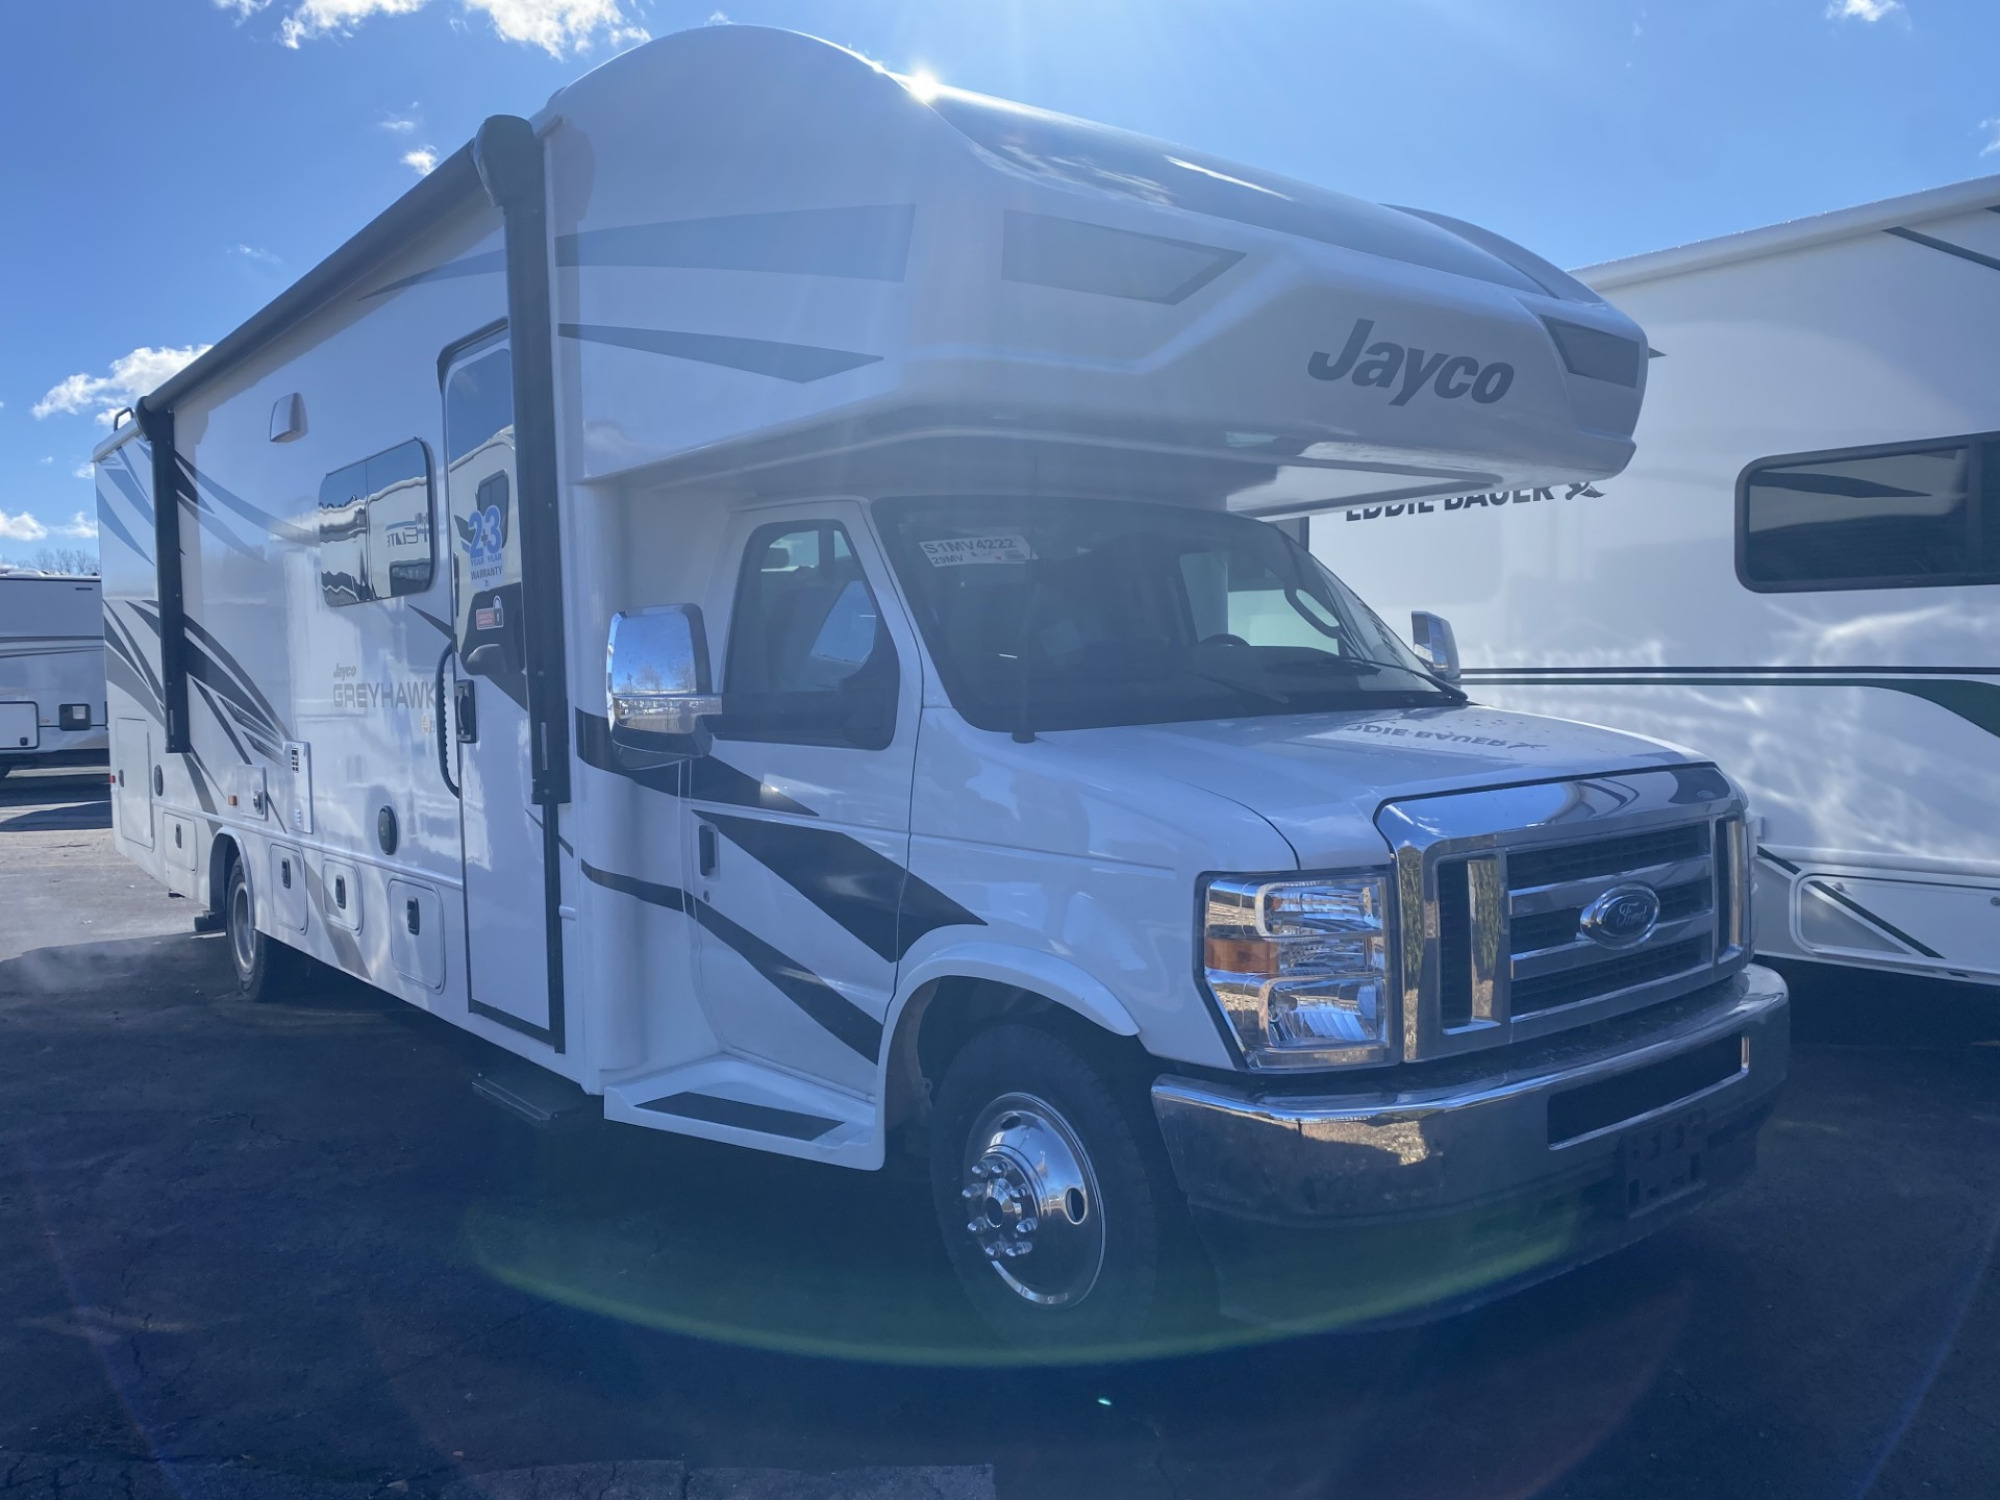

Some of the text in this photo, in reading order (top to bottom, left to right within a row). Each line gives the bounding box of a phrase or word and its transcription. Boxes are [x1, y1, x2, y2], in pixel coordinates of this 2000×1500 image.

[1307, 318, 1514, 406] Jayco
[923, 538, 1017, 554] S1MV4222
[471, 566, 502, 580] WARRANTY
[333, 663, 357, 681] Jayco
[333, 682, 436, 709] GREYHAWK
[1617, 902, 1648, 926] Ford
